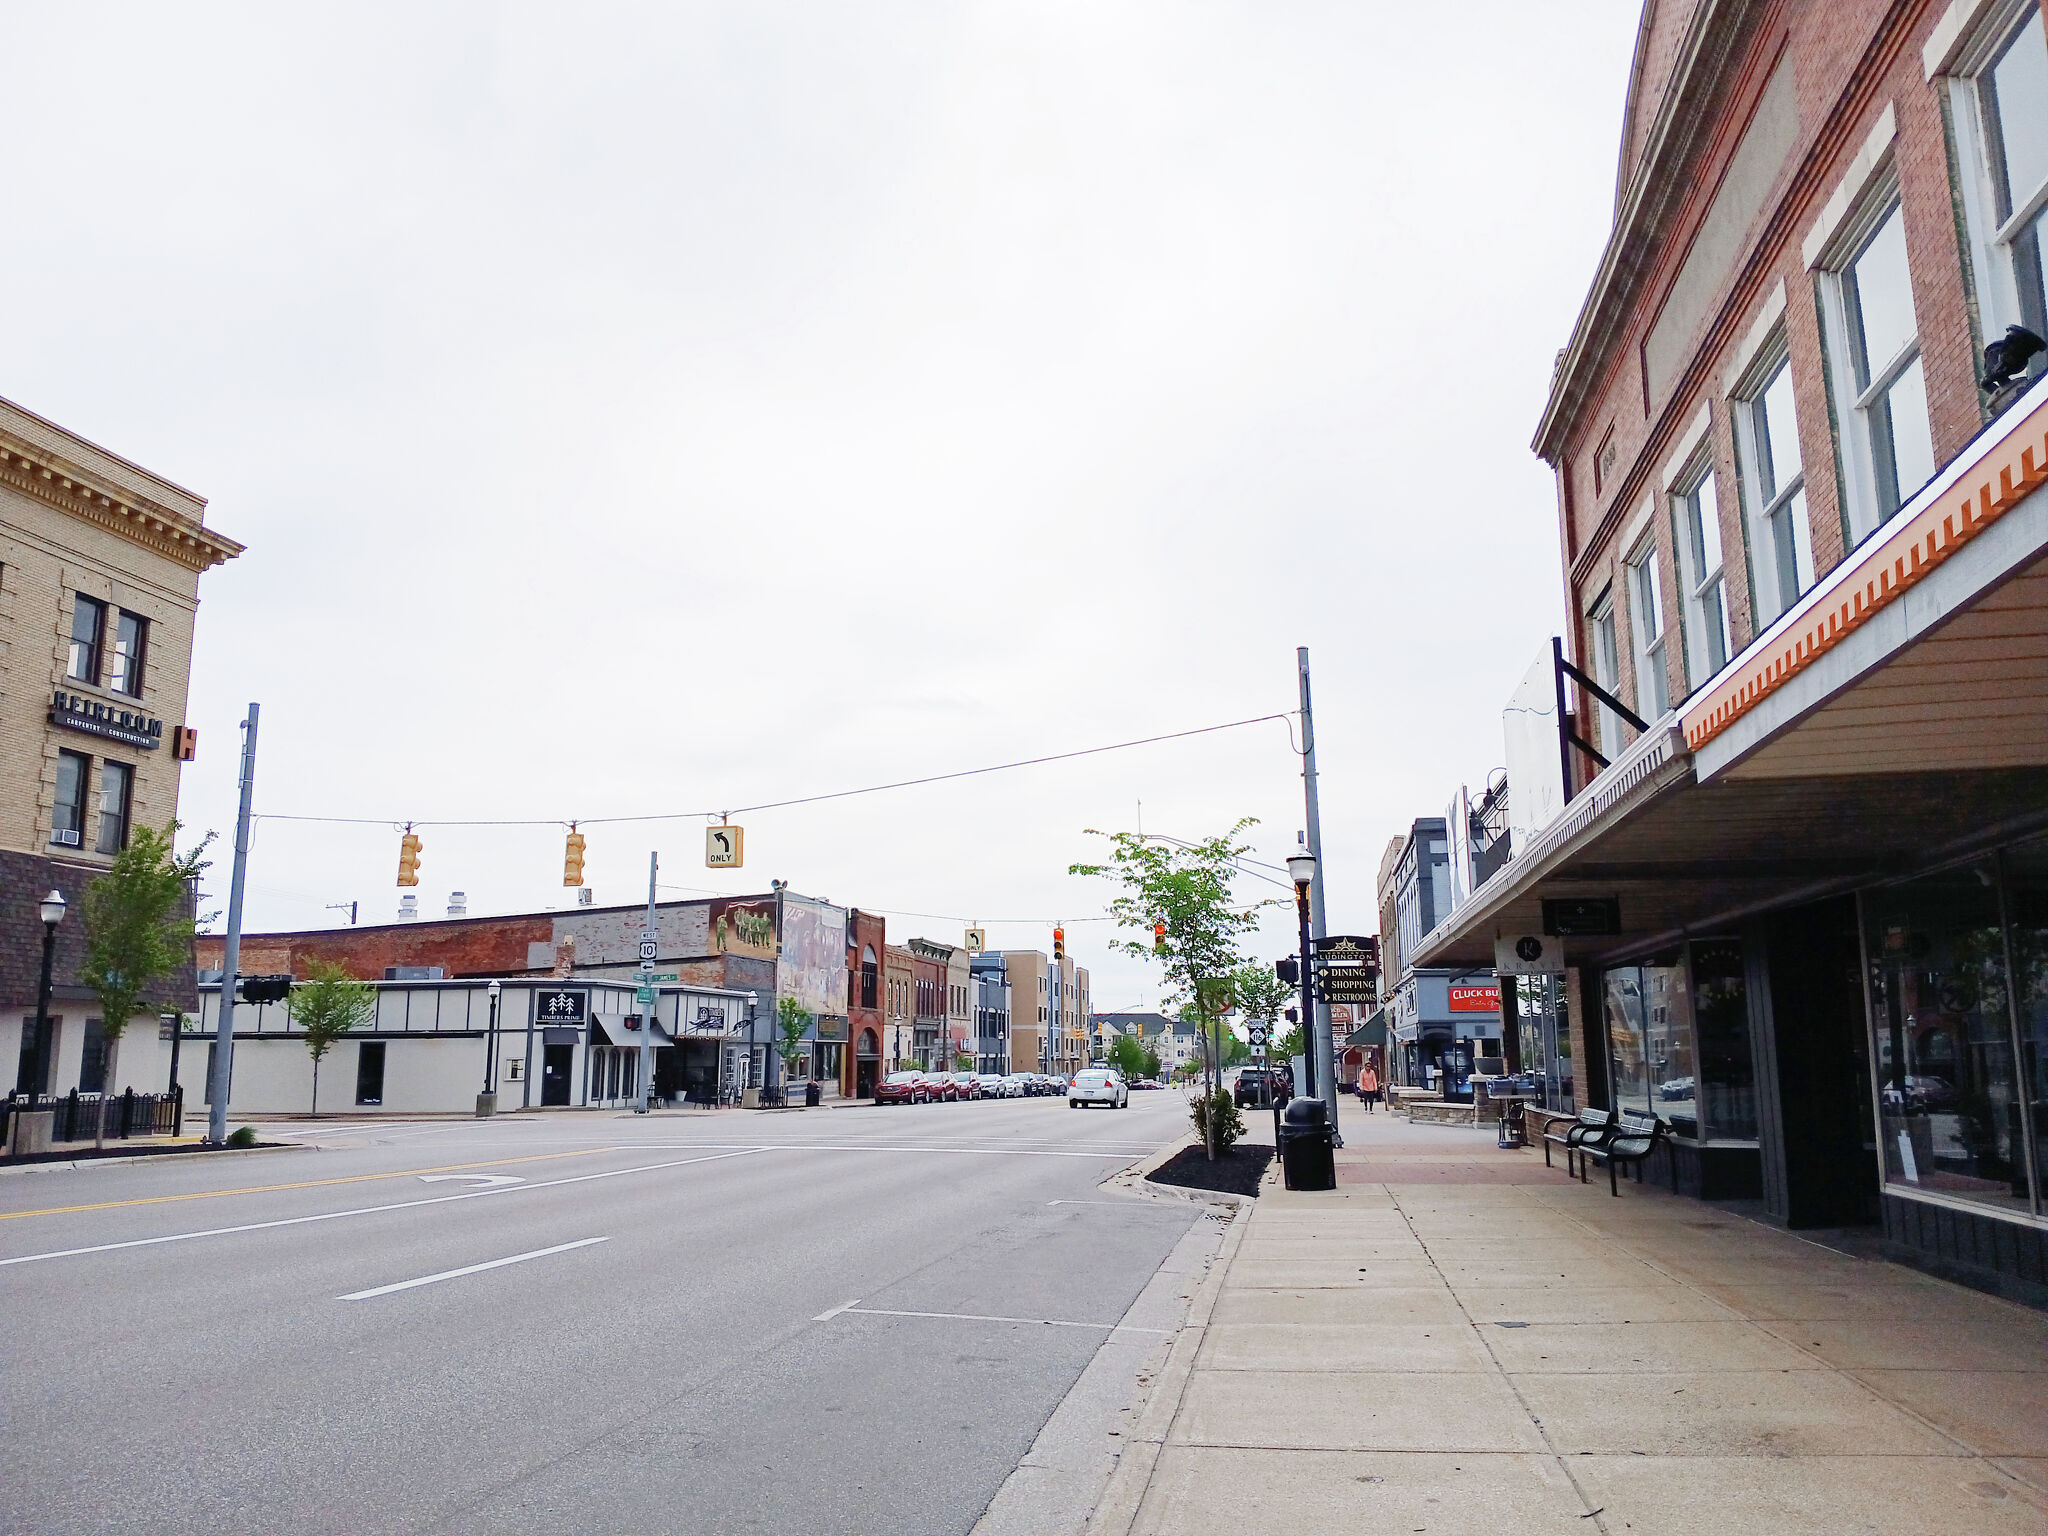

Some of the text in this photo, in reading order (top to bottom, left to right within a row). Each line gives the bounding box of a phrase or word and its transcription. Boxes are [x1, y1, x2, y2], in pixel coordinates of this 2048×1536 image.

[54, 691, 162, 738] HEIRLOOM
[66, 717, 150, 745] CARPENTRY CONSTRUCTION
[174, 726, 197, 761] H
[710, 854, 731, 862] ONLY
[643, 945, 653, 955] 10
[1524, 942, 1535, 956] K
[1331, 968, 1366, 977] DINING
[1331, 980, 1375, 989] SHOPPING
[1332, 993, 1377, 1001] RESTROOMS
[1452, 989, 1483, 1000] CLUCK
